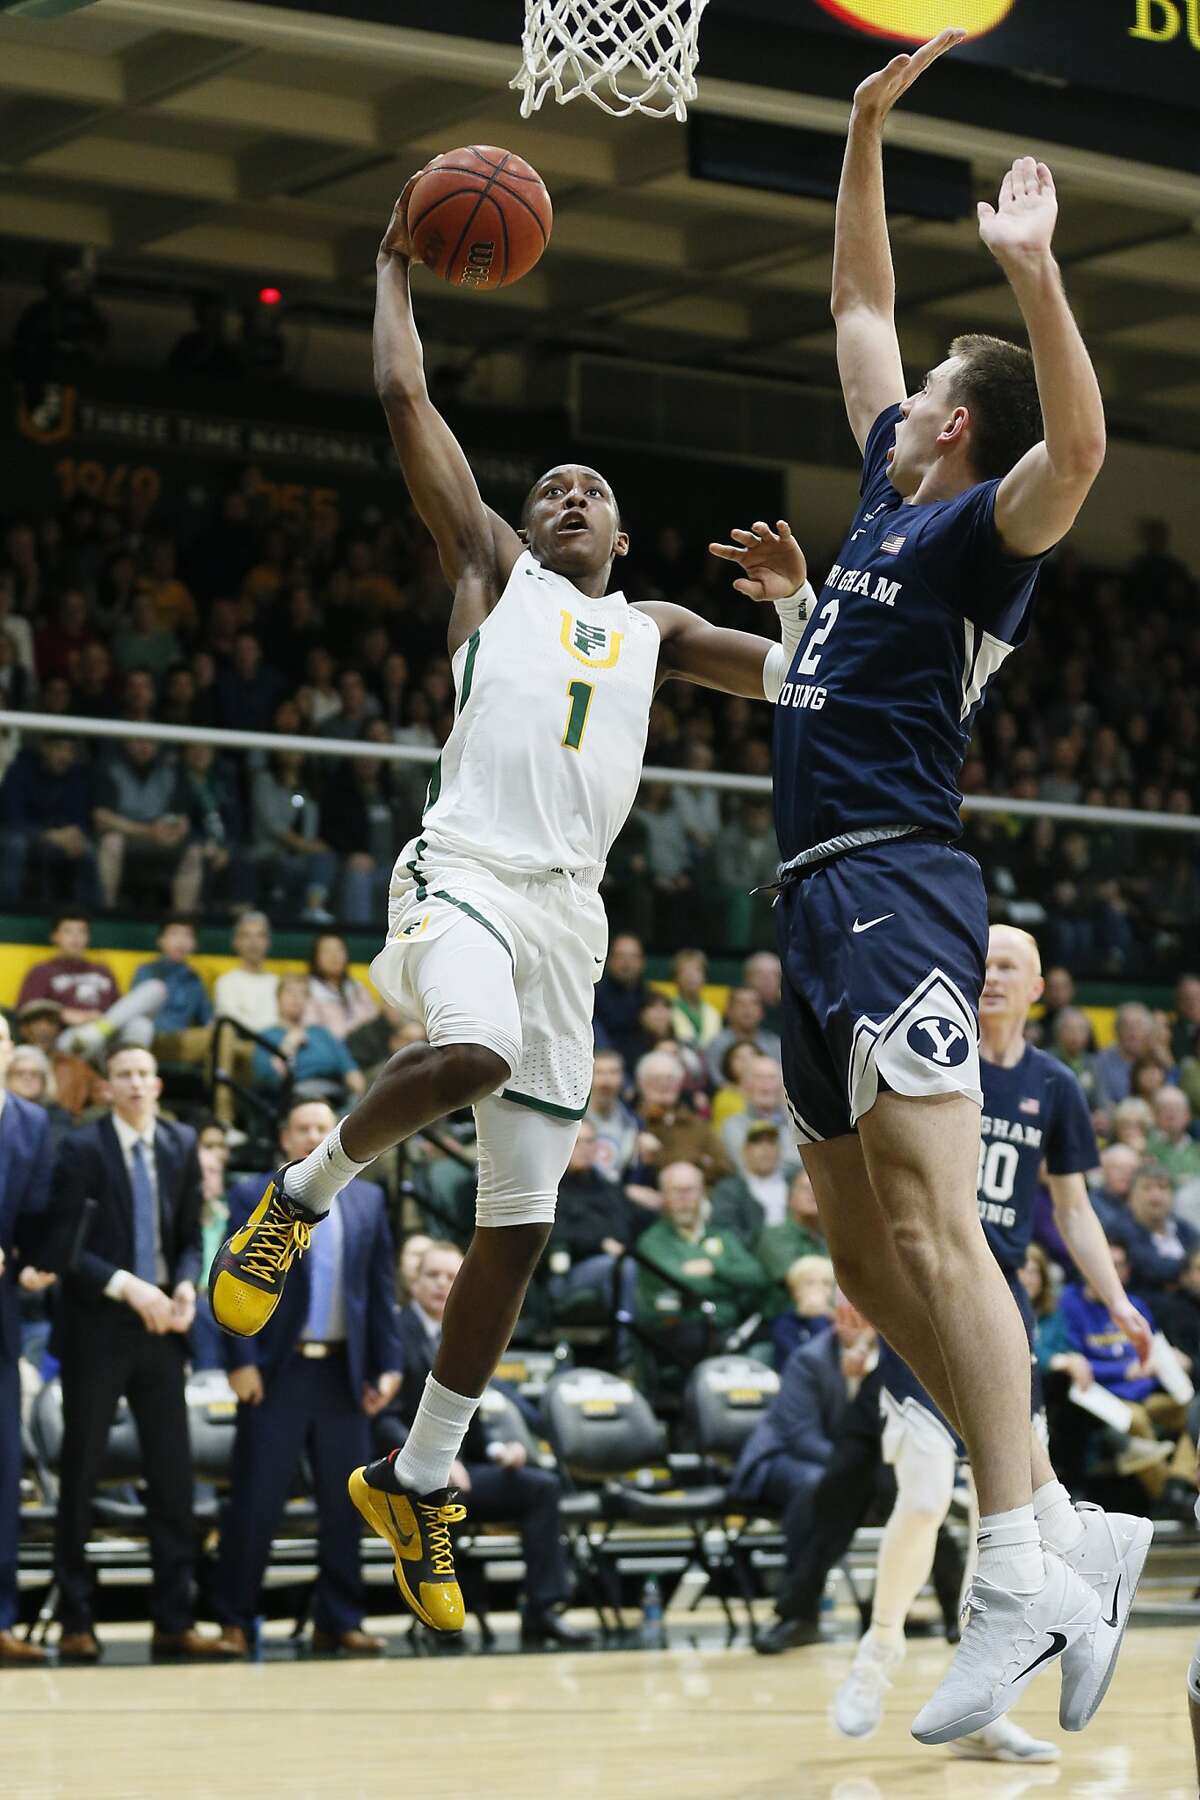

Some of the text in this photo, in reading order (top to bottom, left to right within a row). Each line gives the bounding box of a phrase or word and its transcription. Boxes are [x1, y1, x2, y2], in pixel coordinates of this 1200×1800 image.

[80, 404, 169, 443] THREE
[177, 417, 242, 450] TIME
[796, 598, 840, 676] 2
[560, 678, 597, 753] 1
